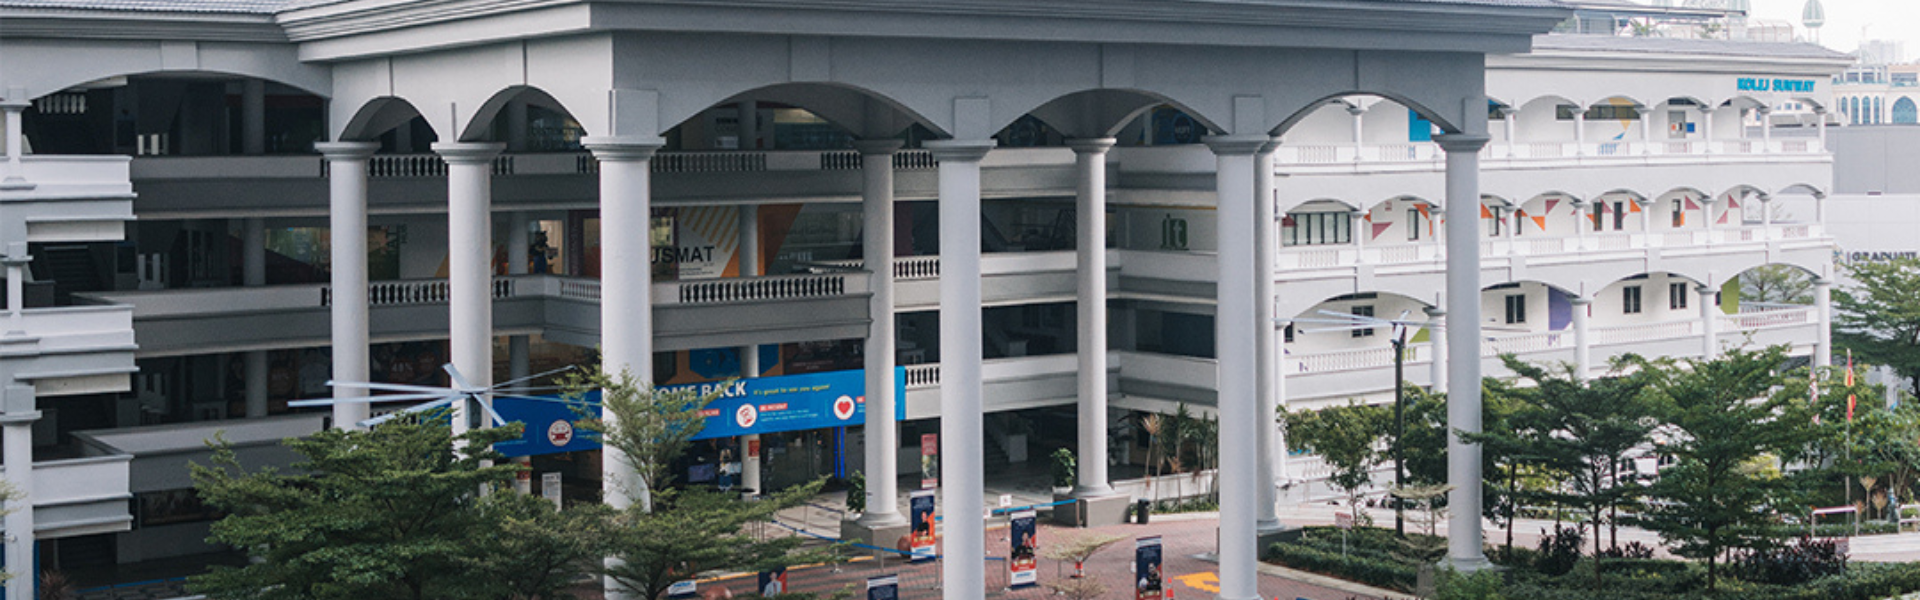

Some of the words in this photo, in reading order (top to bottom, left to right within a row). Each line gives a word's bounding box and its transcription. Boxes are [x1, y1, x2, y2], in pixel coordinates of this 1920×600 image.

[1737, 78, 1770, 92] KOLEJ
[1772, 79, 1815, 93] SUNWAY
[702, 381, 746, 398] BACK
